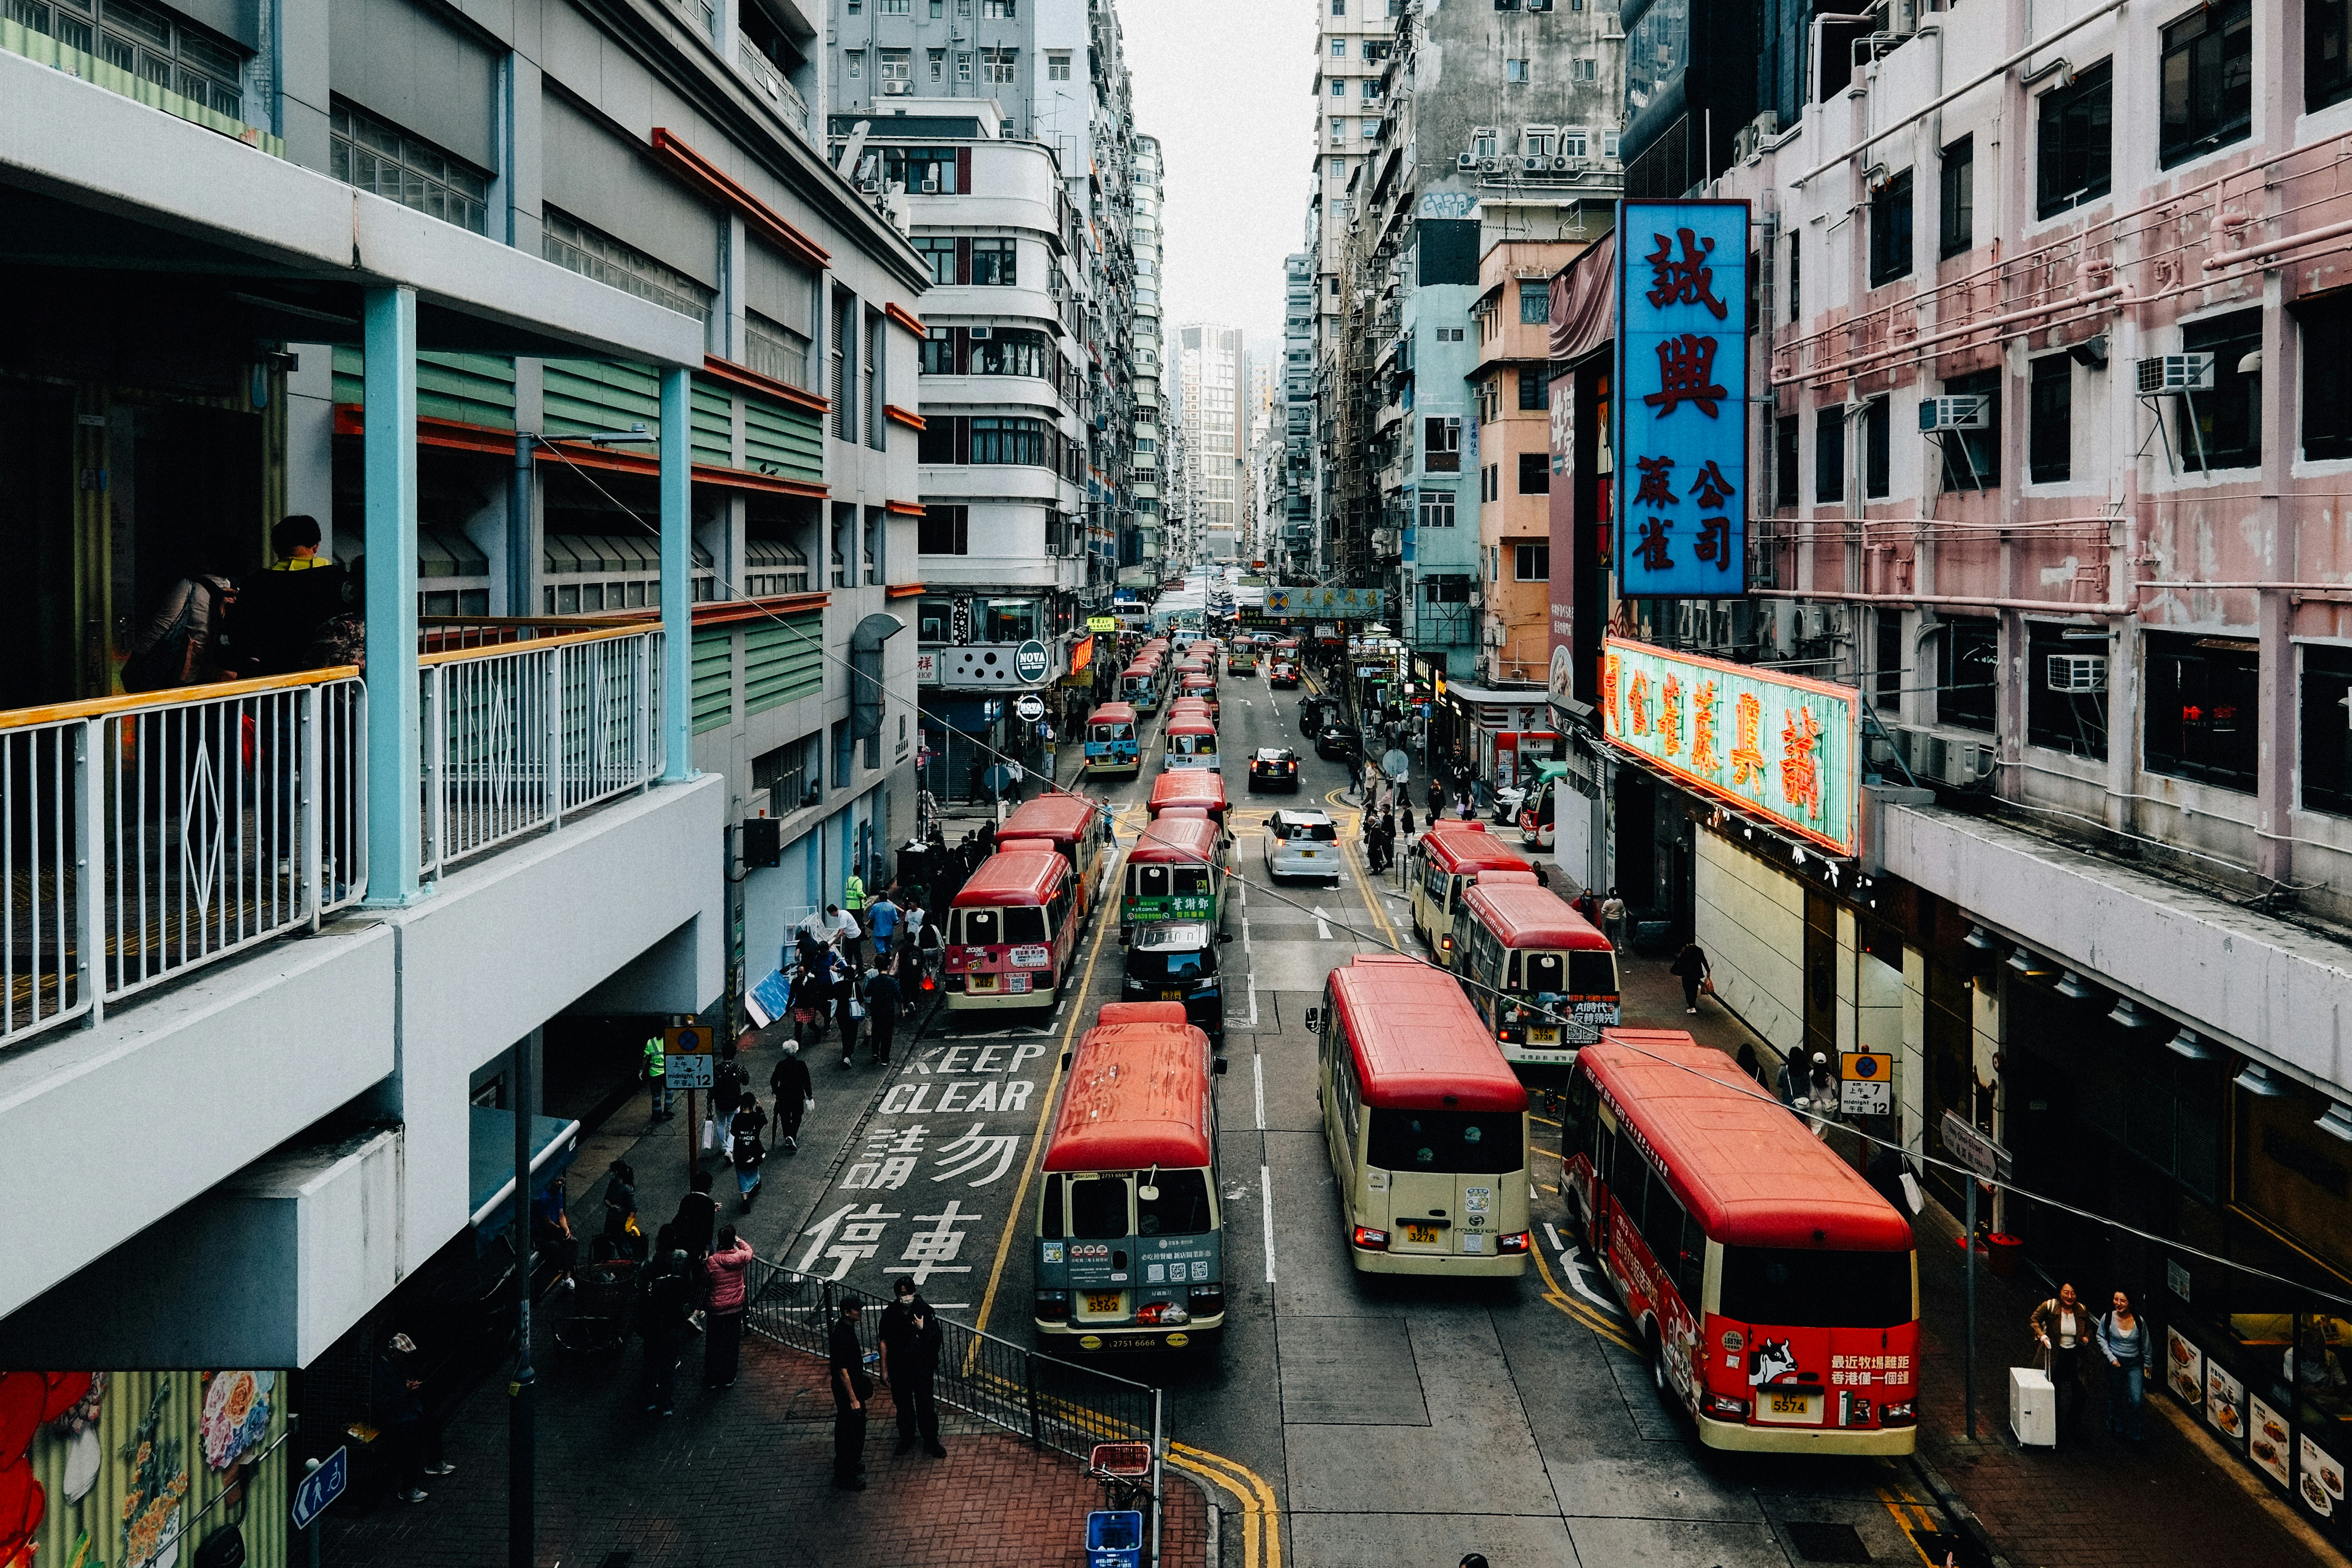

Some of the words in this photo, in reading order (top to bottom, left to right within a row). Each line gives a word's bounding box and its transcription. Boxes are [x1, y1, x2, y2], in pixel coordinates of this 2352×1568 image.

[1644, 227, 1728, 418] 誠興
[1689, 460, 1736, 571] 公司
[1019, 652, 1045, 662] NOVA
[1530, 740, 1540, 748] Hi
[1172, 898, 1209, 911] 葉謝鄧
[1575, 1003, 1607, 1013] AI時代
[1574, 1013, 1614, 1024] 反轉領先
[695, 1057, 703, 1068] 7
[901, 1044, 1046, 1075] KEEP
[696, 1074, 710, 1086] 12
[1872, 1084, 1880, 1095] 7
[878, 1080, 1035, 1114] CLEAR
[1615, 1102, 1626, 1122] SEATS
[1873, 1102, 1887, 1114] 12
[1969, 1139, 1983, 1154] Street
[838, 1122, 1020, 1190] 請勿
[791, 1200, 982, 1285] 停車
[1409, 1233, 1435, 1243] 3278
[1090, 1302, 1117, 1311] 5562
[1831, 1356, 1910, 1369] 最近牧場離距
[1831, 1371, 1910, 1385] 香港僅一個鐘
[1774, 1401, 1805, 1412] 5574
